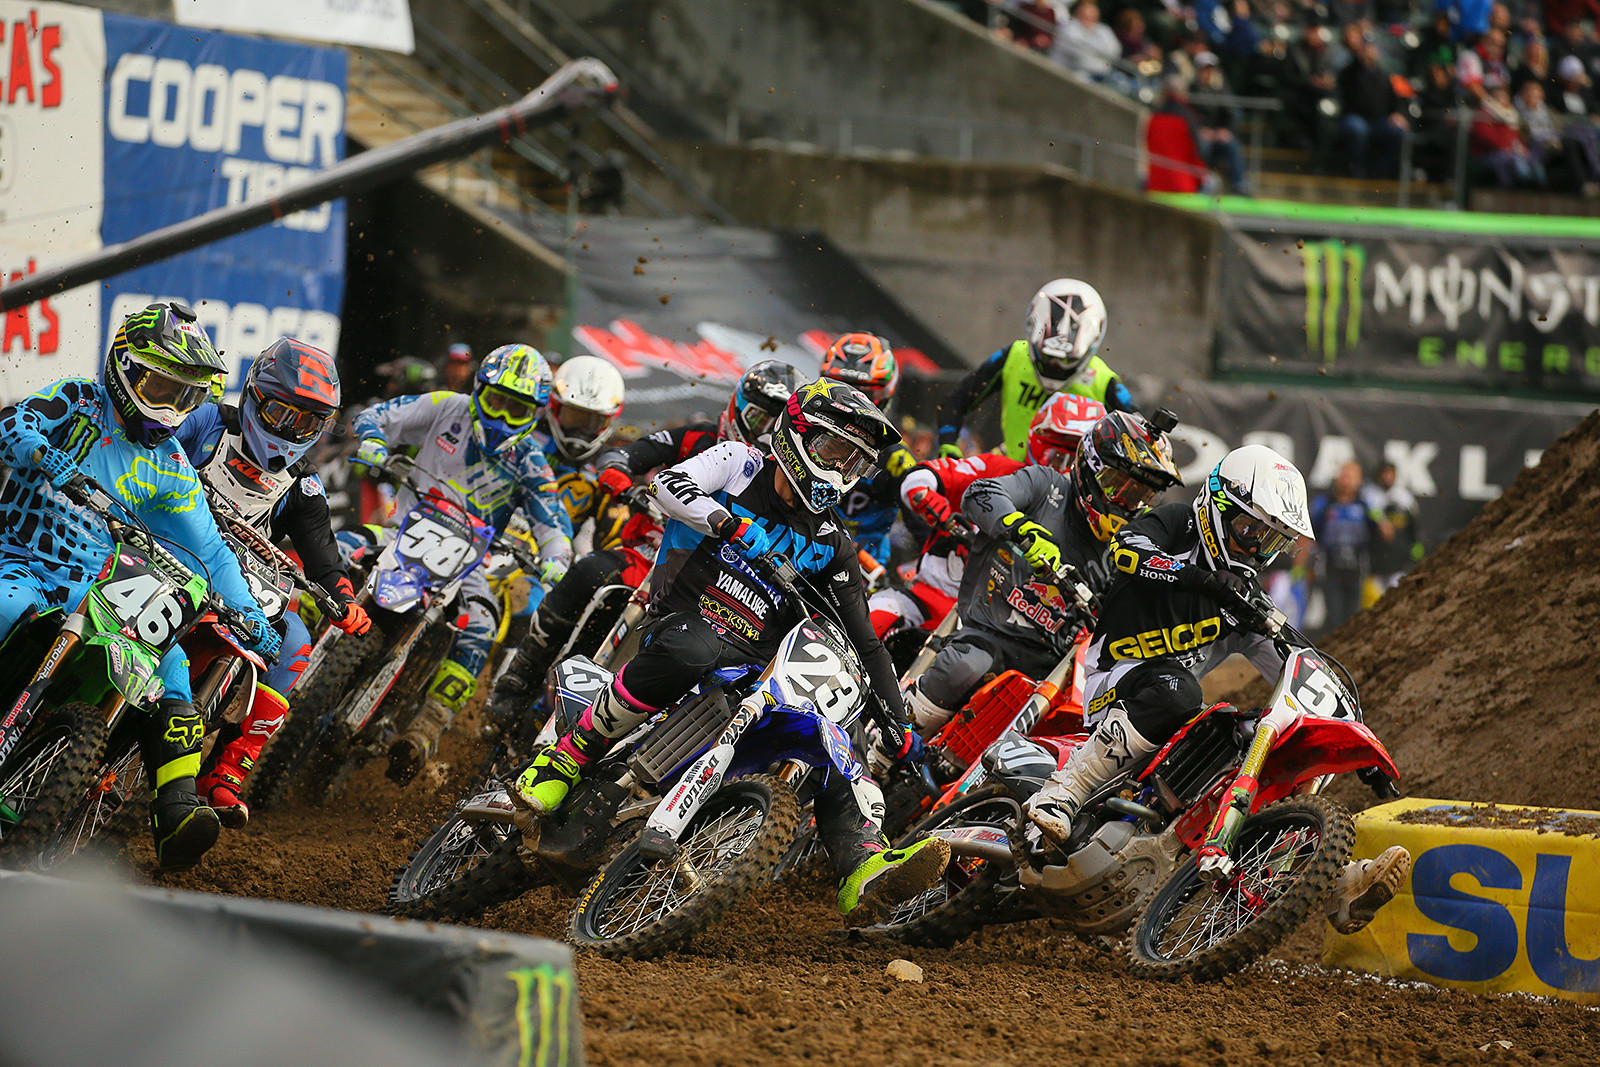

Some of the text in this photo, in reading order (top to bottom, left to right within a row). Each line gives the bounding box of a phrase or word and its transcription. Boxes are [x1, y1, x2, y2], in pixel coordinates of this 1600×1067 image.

[0, 10, 62, 108] A'S
[108, 53, 344, 168] COOPER
[41, 506, 71, 526] PRO
[1198, 506, 1220, 559] GEICO
[397, 517, 477, 578] 58
[100, 573, 183, 646] 46
[714, 570, 770, 621] YAMALUBE
[50, 636, 70, 660] PRO
[1108, 615, 1222, 662] GEICO
[783, 642, 861, 724] 23
[1087, 687, 1117, 716] GEICO
[1296, 668, 1356, 721] 51
[3, 690, 31, 729] BRAKING
[664, 784, 687, 812] BRAKING
[578, 872, 606, 915] DUNLOP
